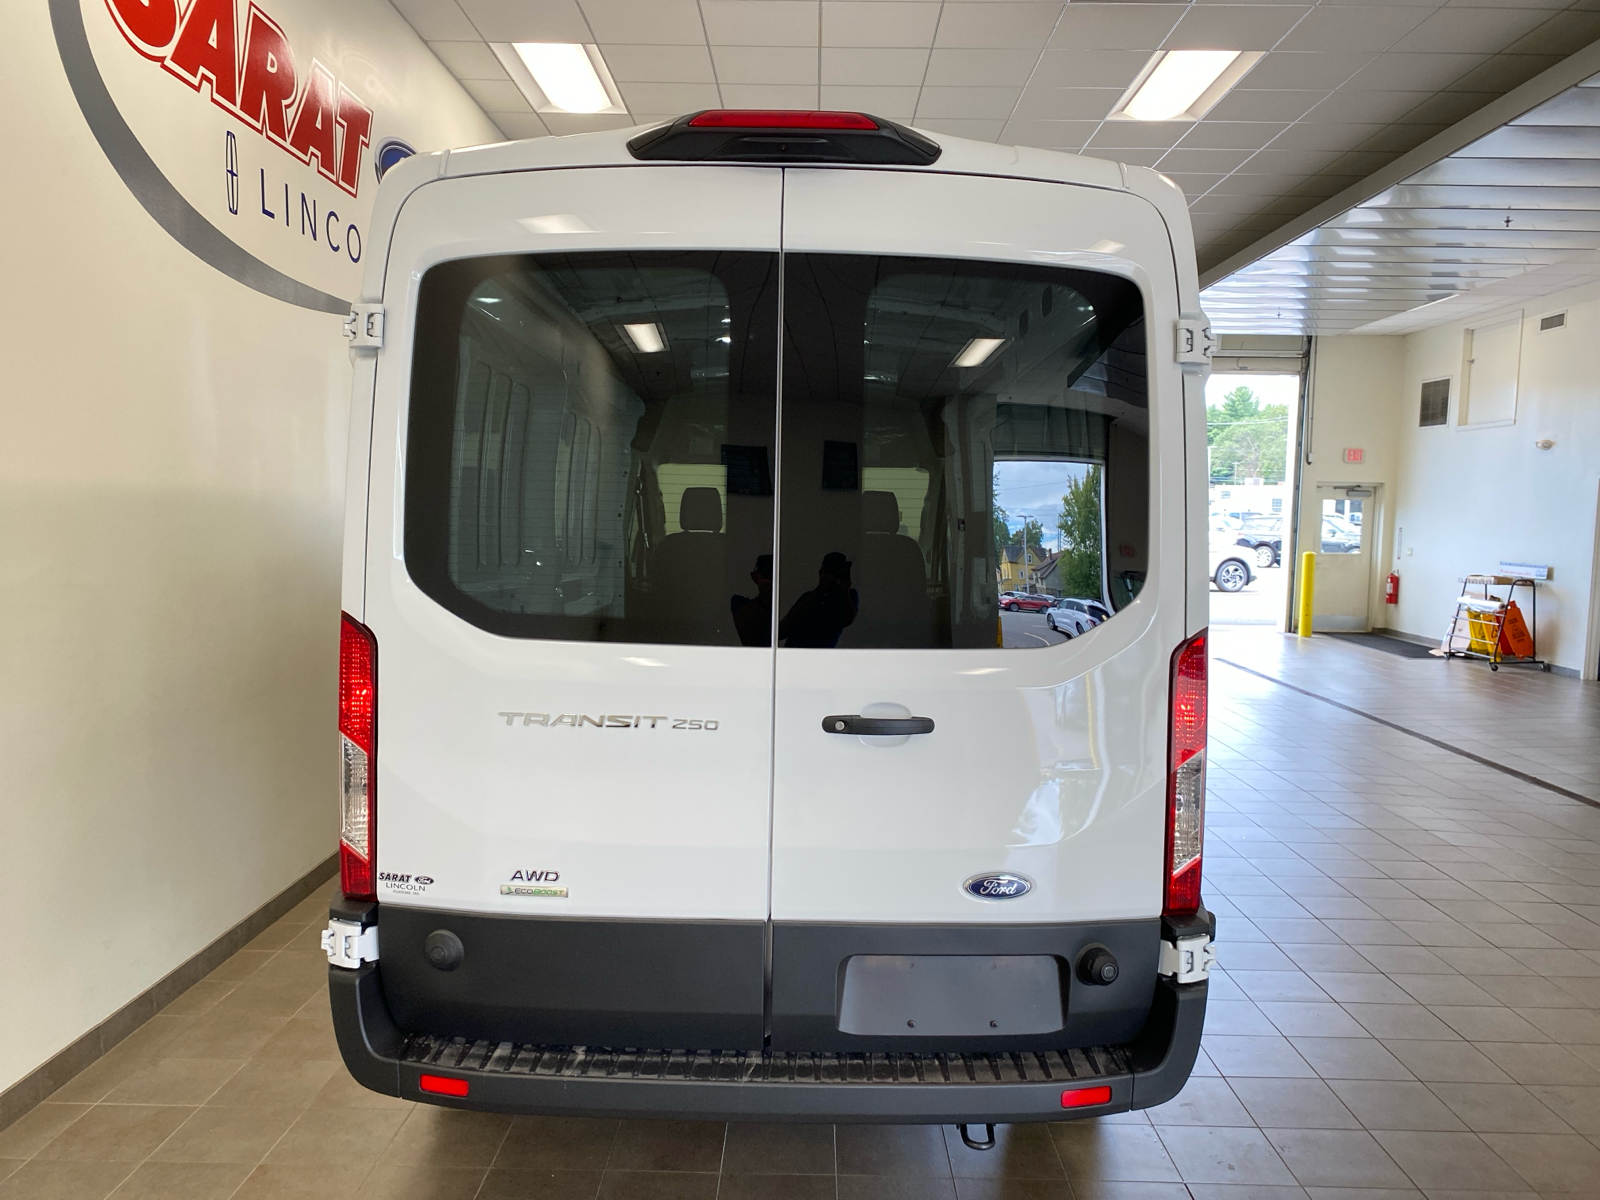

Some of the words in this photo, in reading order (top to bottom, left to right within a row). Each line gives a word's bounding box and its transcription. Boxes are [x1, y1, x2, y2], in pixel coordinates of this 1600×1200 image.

[260, 168, 362, 264] LINCO
[1347, 448, 1363, 461] EXIT
[498, 711, 668, 728] TRANSIT
[672, 718, 719, 730] 250
[379, 872, 412, 883] SARAT
[509, 870, 560, 882] AWD
[385, 882, 426, 892] LINCOLN
[980, 879, 1018, 895] Ford
